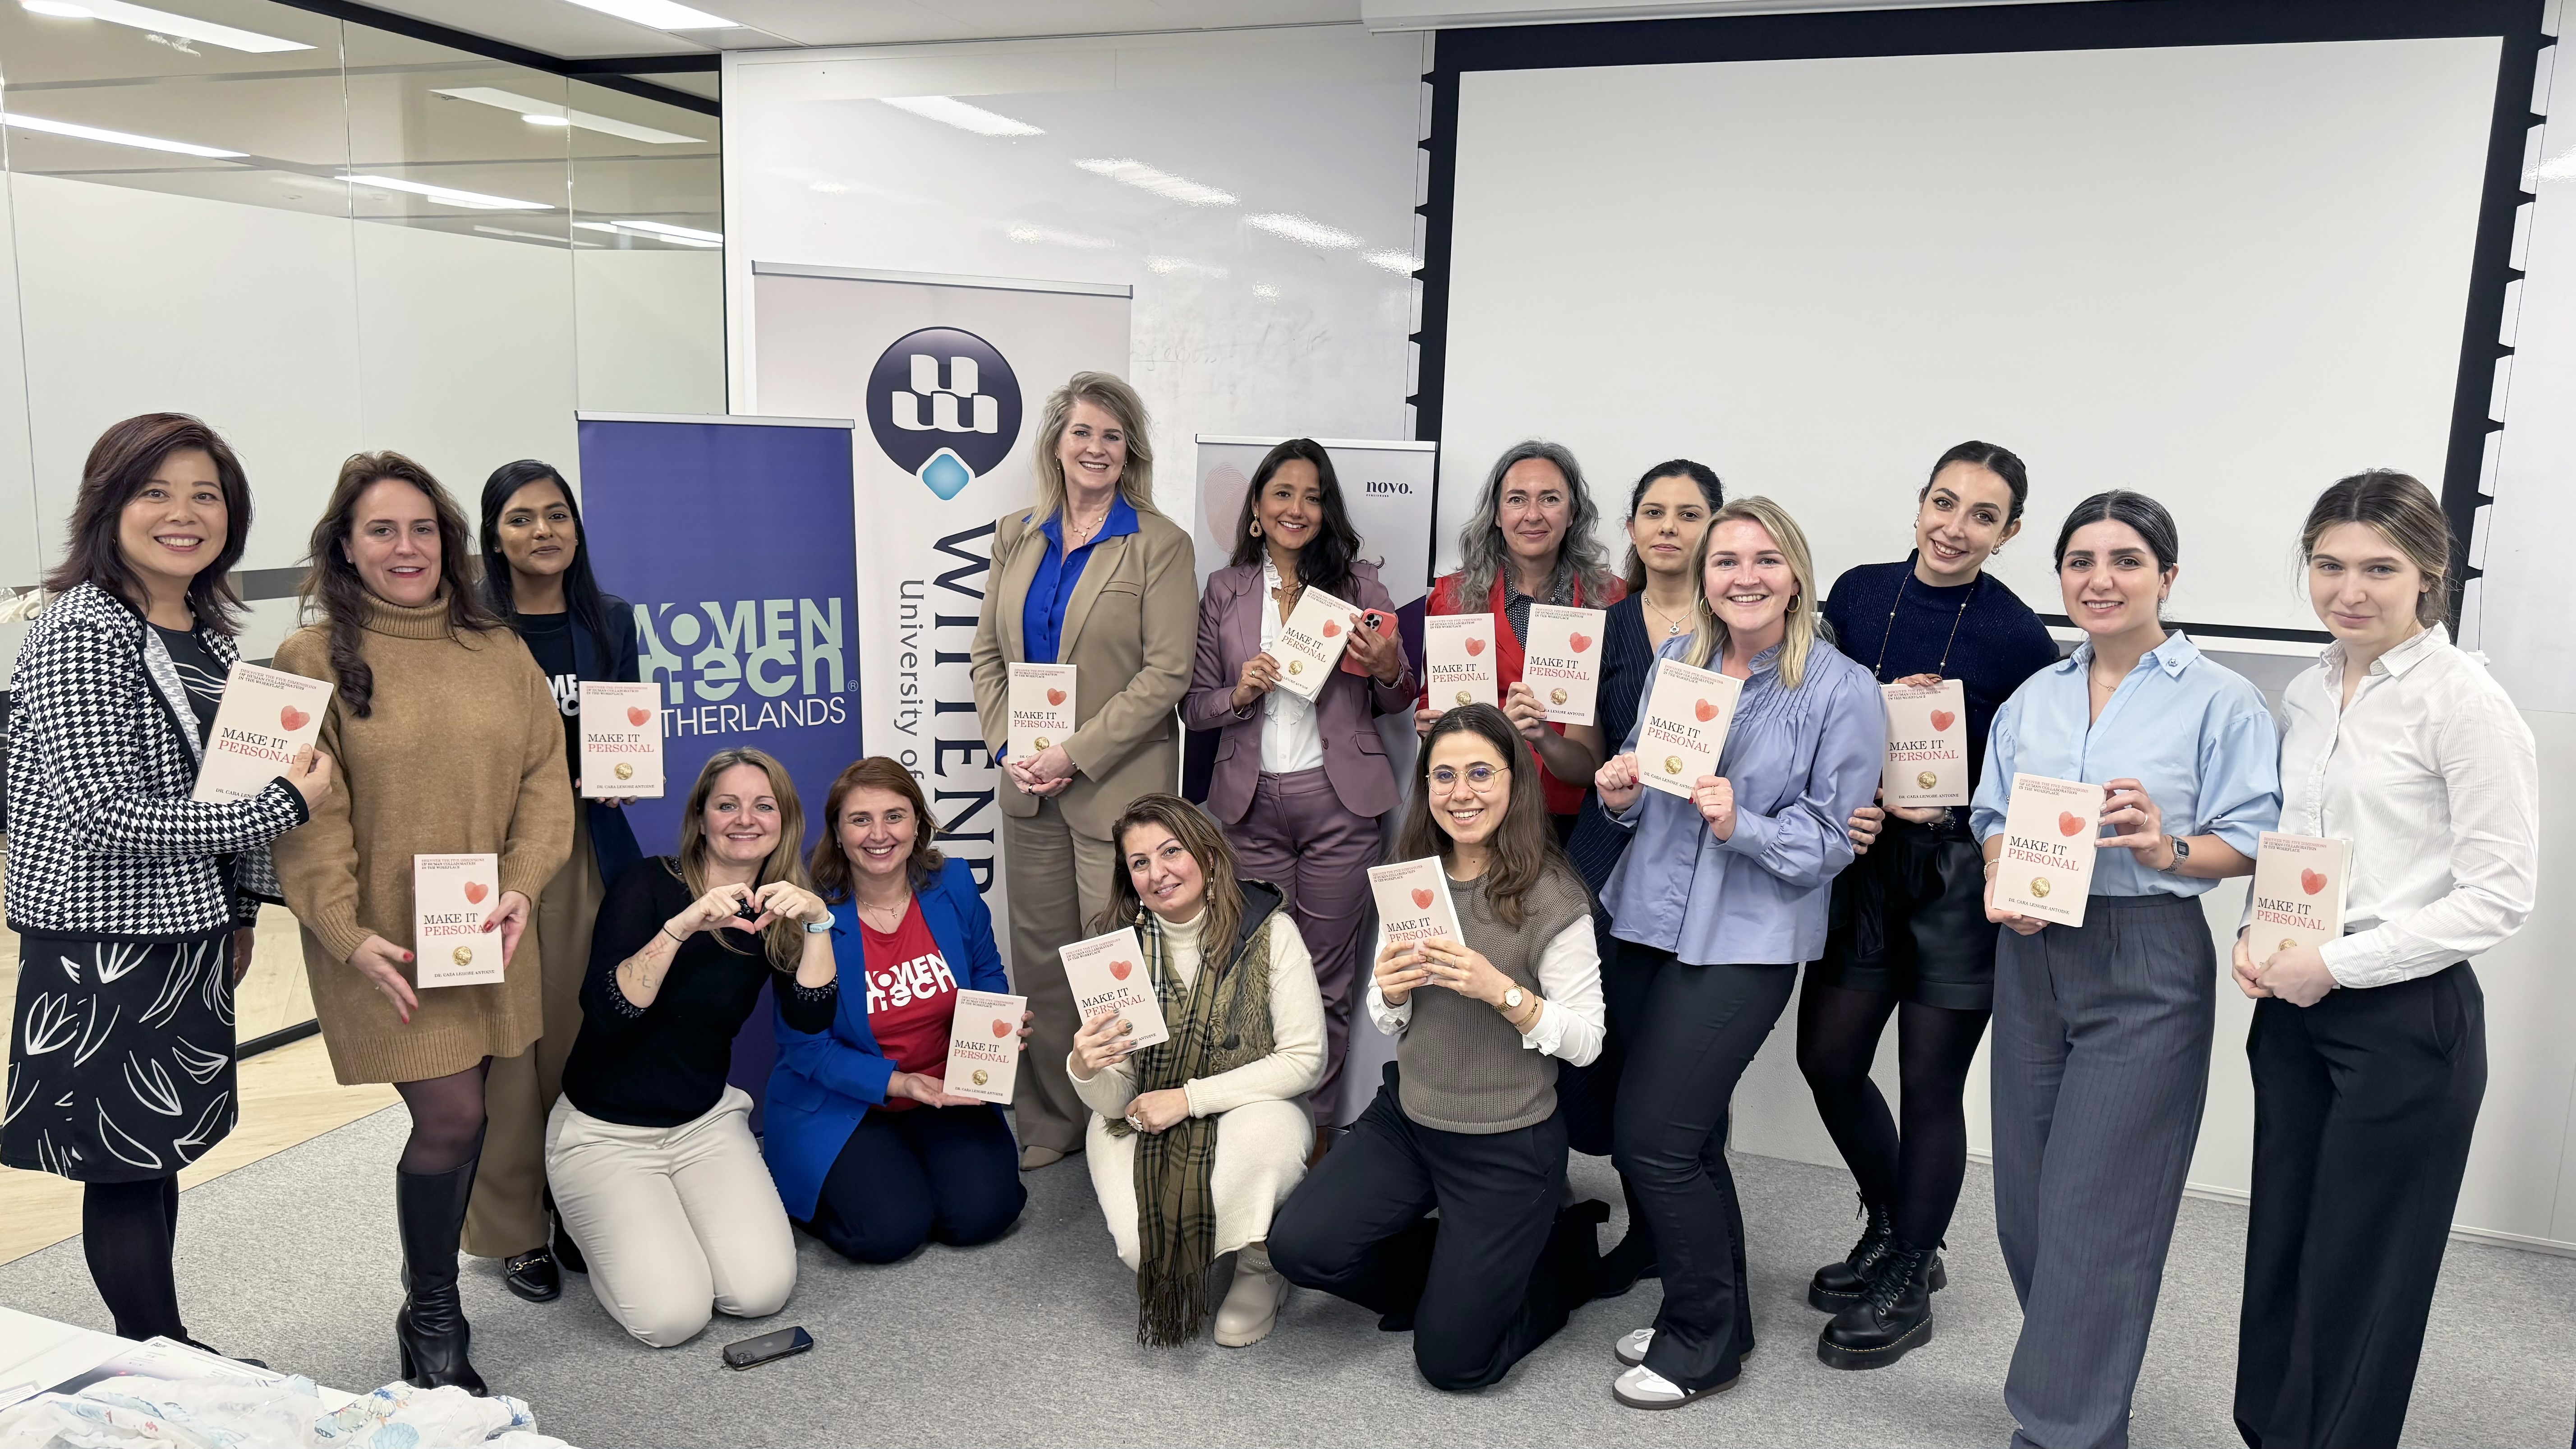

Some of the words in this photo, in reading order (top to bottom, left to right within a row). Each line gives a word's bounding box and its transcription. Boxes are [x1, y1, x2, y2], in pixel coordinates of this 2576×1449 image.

[1366, 482, 1412, 494] novo.
[1285, 627, 1312, 644] MAKE
[1311, 640, 1323, 650] IT
[1281, 635, 1328, 662] PERSONAL
[894, 580, 924, 736] University
[1530, 656, 1563, 667] MAKE
[1566, 660, 1578, 668] IT
[1432, 664, 1462, 673] MAKE
[1433, 672, 1488, 682] PERSONAL
[1529, 666, 1590, 680] PERSONAL
[661, 696, 846, 738] THERLANDS
[1014, 720, 1067, 728] PERSONAL
[1649, 716, 1685, 734] MAKE
[1687, 727, 1700, 739] IT
[221, 727, 268, 745] MAKE
[271, 737, 288, 750] IT
[1646, 727, 1711, 754] PERSONAL
[1890, 741, 1926, 750] MAKE
[1931, 740, 1944, 748] IT
[900, 749, 924, 780] of
[1890, 750, 1959, 761] PERSONAL
[2009, 836, 2049, 852] MAKE
[2052, 844, 2067, 856] IT
[2007, 848, 2080, 871] PERSONAL
[2257, 897, 2294, 912] MAKE
[2297, 903, 2310, 915] IT
[424, 914, 461, 924] MAKE
[465, 913, 478, 922] IT
[1385, 920, 1417, 933] MAKE
[1418, 917, 1431, 927] IT
[2256, 910, 2324, 930] PERSONAL
[425, 923, 485, 936] PERSONA
[1388, 925, 1446, 943] PERSONAL
[1081, 991, 1115, 1007] MAKE
[1116, 987, 1129, 998] IT
[1084, 994, 1145, 1018] PERSONAL
[955, 1040, 985, 1050] MAKE
[988, 1044, 999, 1052] IT
[953, 1049, 1009, 1063] PERSONAL
